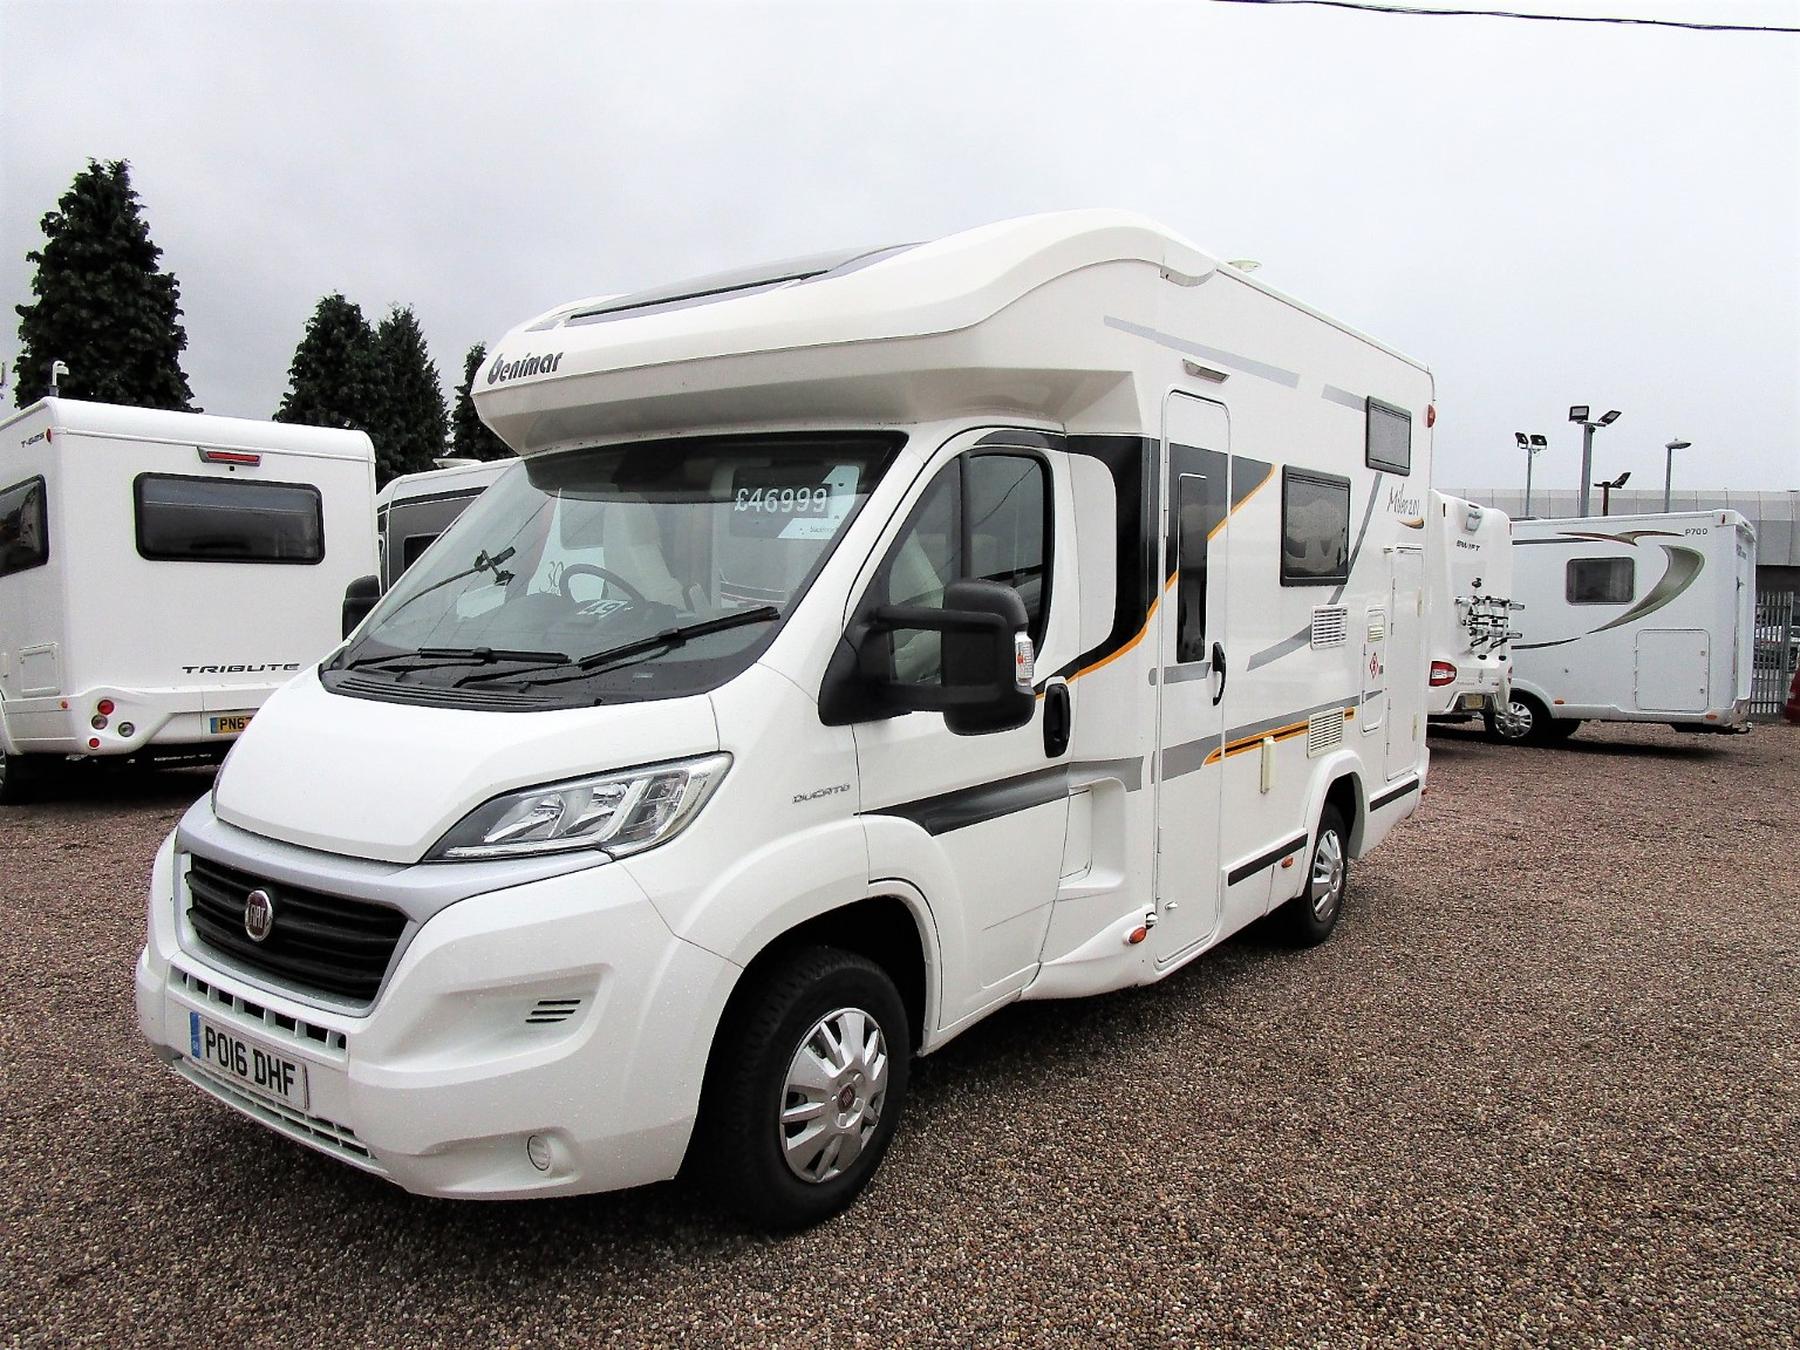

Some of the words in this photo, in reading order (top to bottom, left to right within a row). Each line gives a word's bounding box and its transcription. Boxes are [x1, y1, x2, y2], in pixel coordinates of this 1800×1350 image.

[734, 487, 828, 513] £46999
[182, 663, 300, 674] TRIBUTE
[792, 784, 851, 803] DUCATO
[250, 903, 266, 929] FIAT
[252, 1048, 296, 1096] DHF
